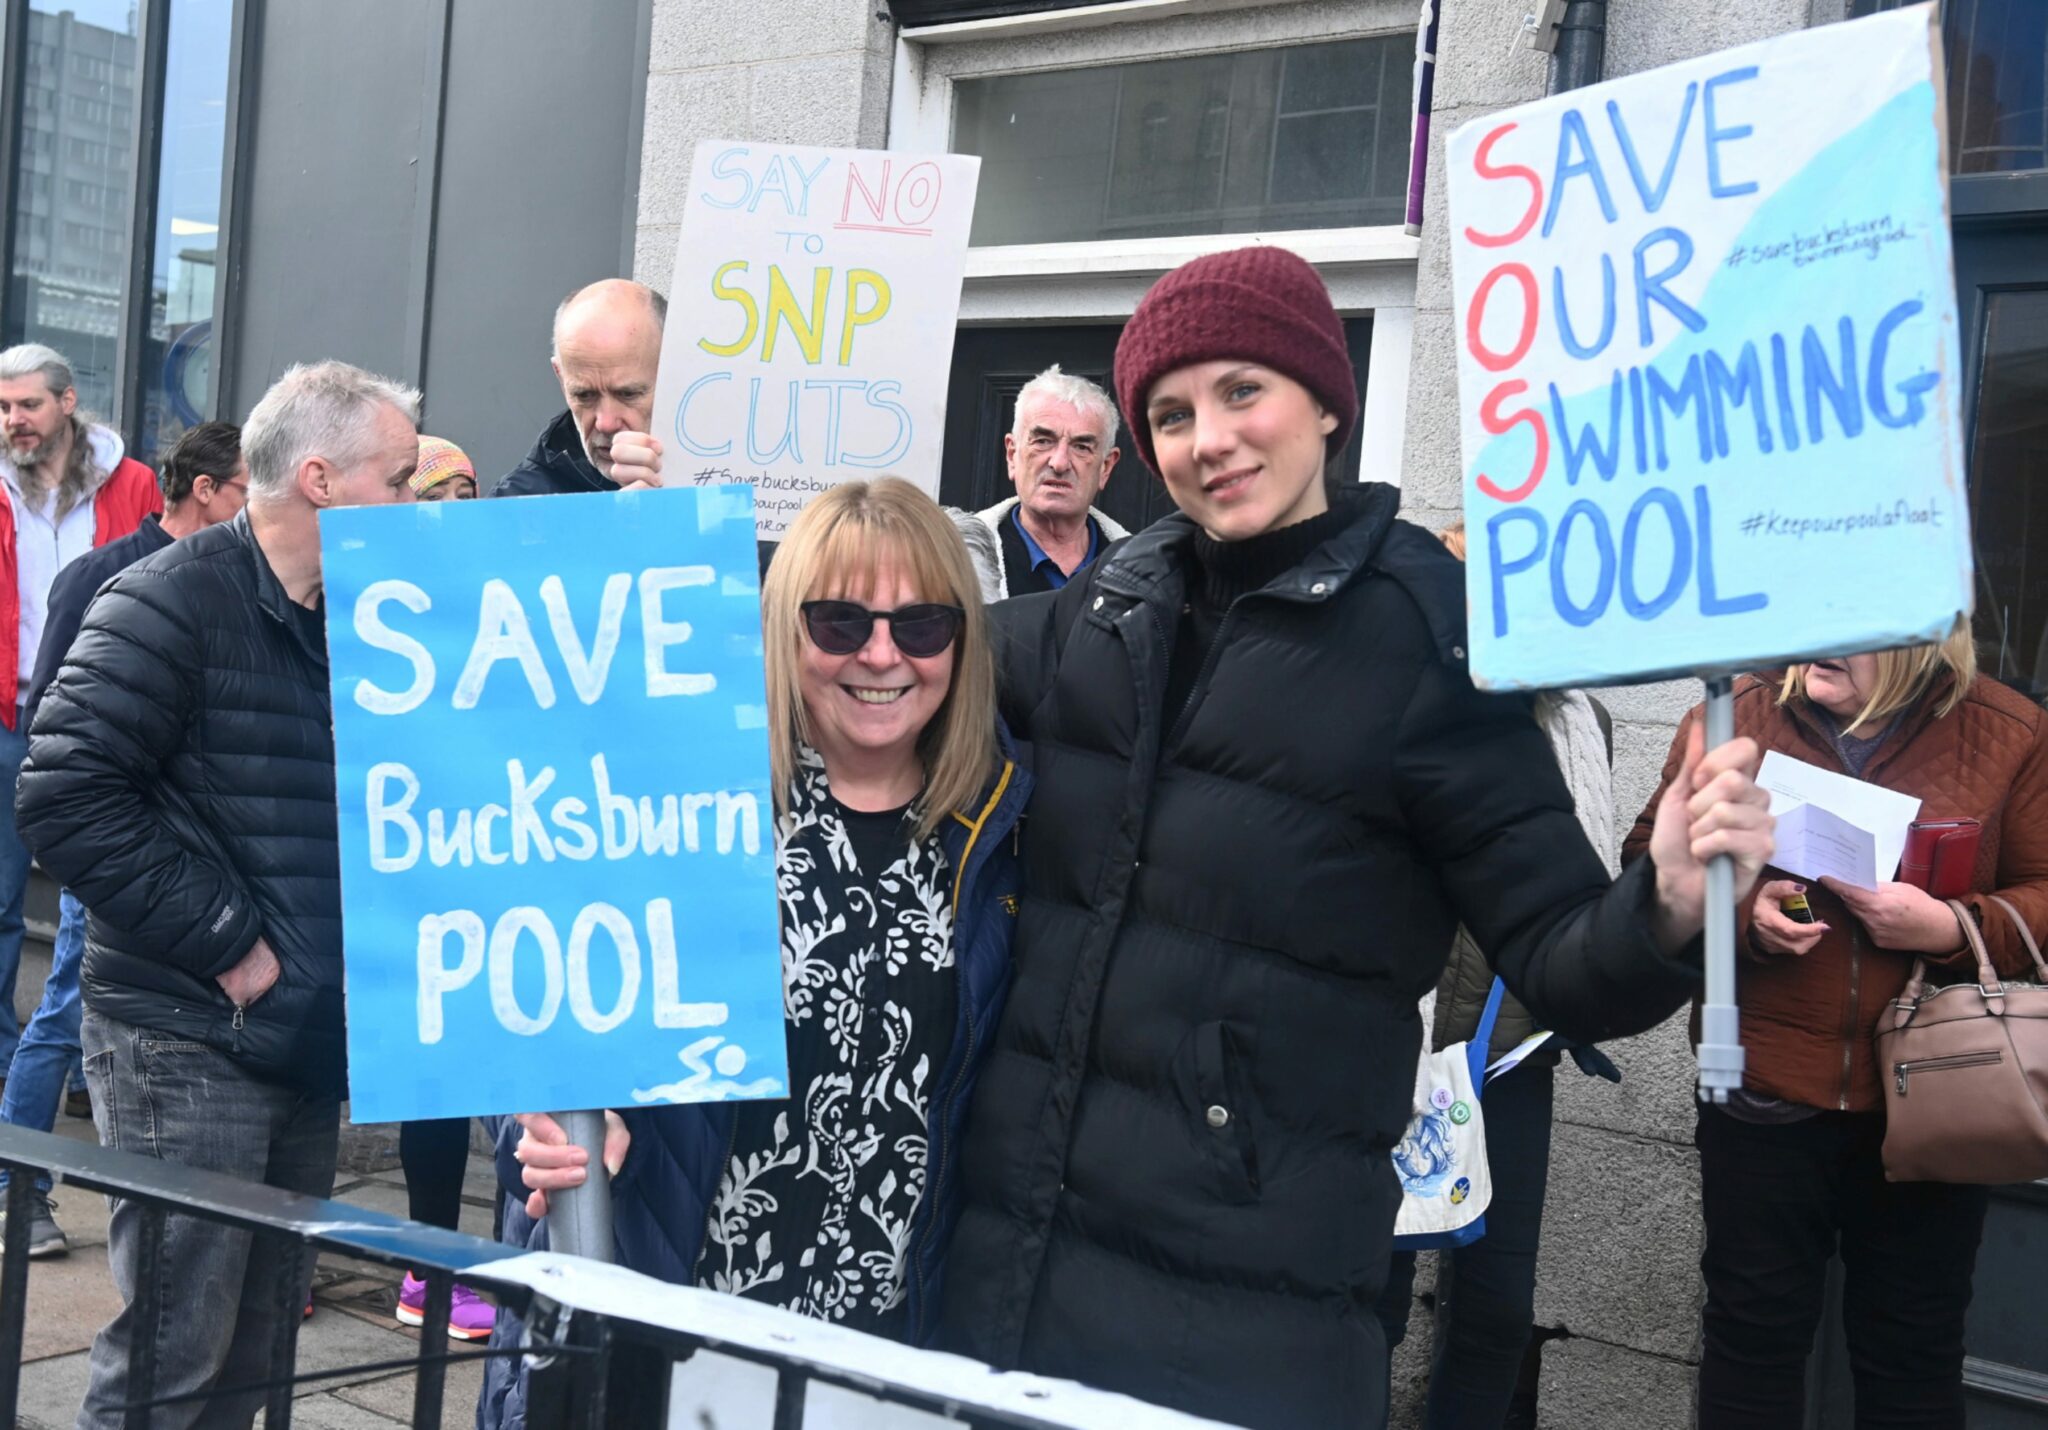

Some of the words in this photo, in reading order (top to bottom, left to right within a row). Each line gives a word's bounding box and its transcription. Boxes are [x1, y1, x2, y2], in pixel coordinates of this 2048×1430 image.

[701, 148, 830, 217] SAY
[840, 159, 942, 225] NO
[1464, 66, 1759, 248] SAVE
[697, 261, 893, 366] SNP
[776, 231, 823, 254] TO
[1466, 227, 1708, 372] OUR
[675, 372, 913, 469] CUTS
[1475, 298, 1941, 502] SWIMMING
[693, 467, 842, 493] #Savebucksbur
[1486, 484, 1769, 639] POOL
[353, 564, 718, 716] SAVE
[417, 897, 729, 1045] POOL
